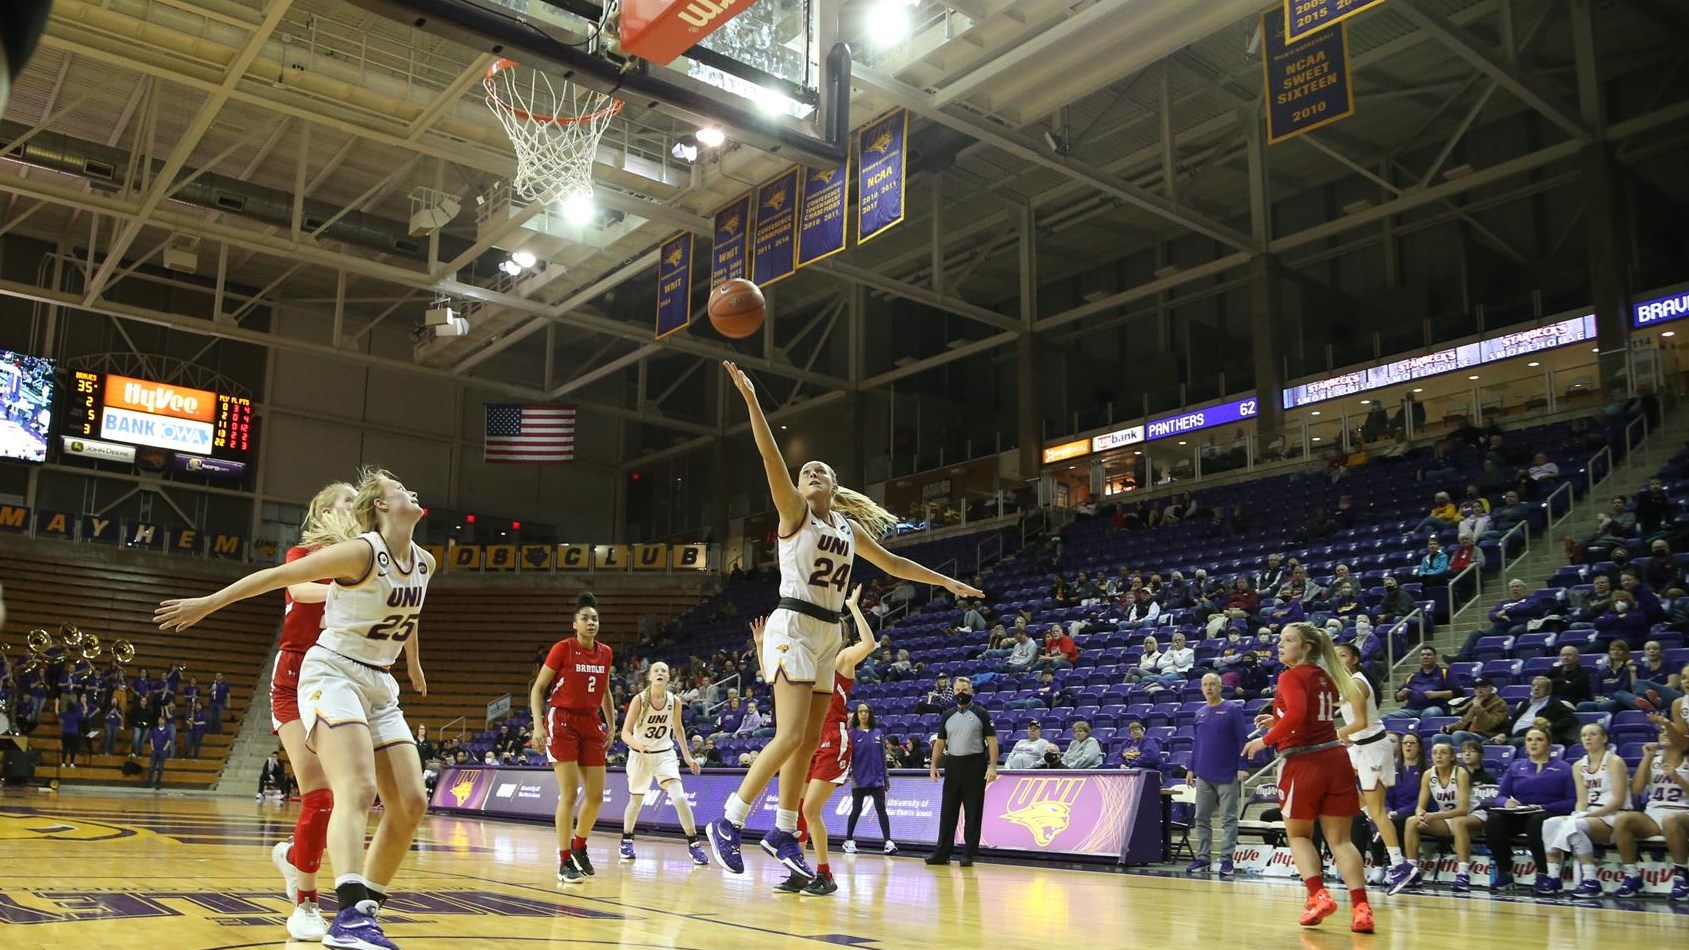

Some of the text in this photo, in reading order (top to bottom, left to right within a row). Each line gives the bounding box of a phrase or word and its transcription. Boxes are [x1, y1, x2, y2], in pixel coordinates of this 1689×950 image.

[1296, 7, 1328, 28] 2015
[1285, 50, 1326, 76] NCAA
[1282, 62, 1330, 89] SWEET
[1276, 72, 1338, 104] SIXTEEN
[1292, 101, 1327, 121] 2010
[867, 165, 893, 188] NCAA
[78, 380, 93, 393] 35
[105, 414, 156, 436] BANK
[1149, 400, 1256, 438] PANTHERS 62
[816, 534, 849, 557] UNI
[808, 557, 851, 592] 24
[387, 586, 422, 608] UNI
[366, 613, 420, 641] 25
[587, 675, 596, 693] 2
[1317, 691, 1334, 721] 11
[647, 714, 668, 724] UNI
[644, 725, 667, 739] 30
[1254, 784, 1279, 798] HyVe
[1436, 790, 1456, 801] UNI
[1652, 787, 1683, 803] 42
